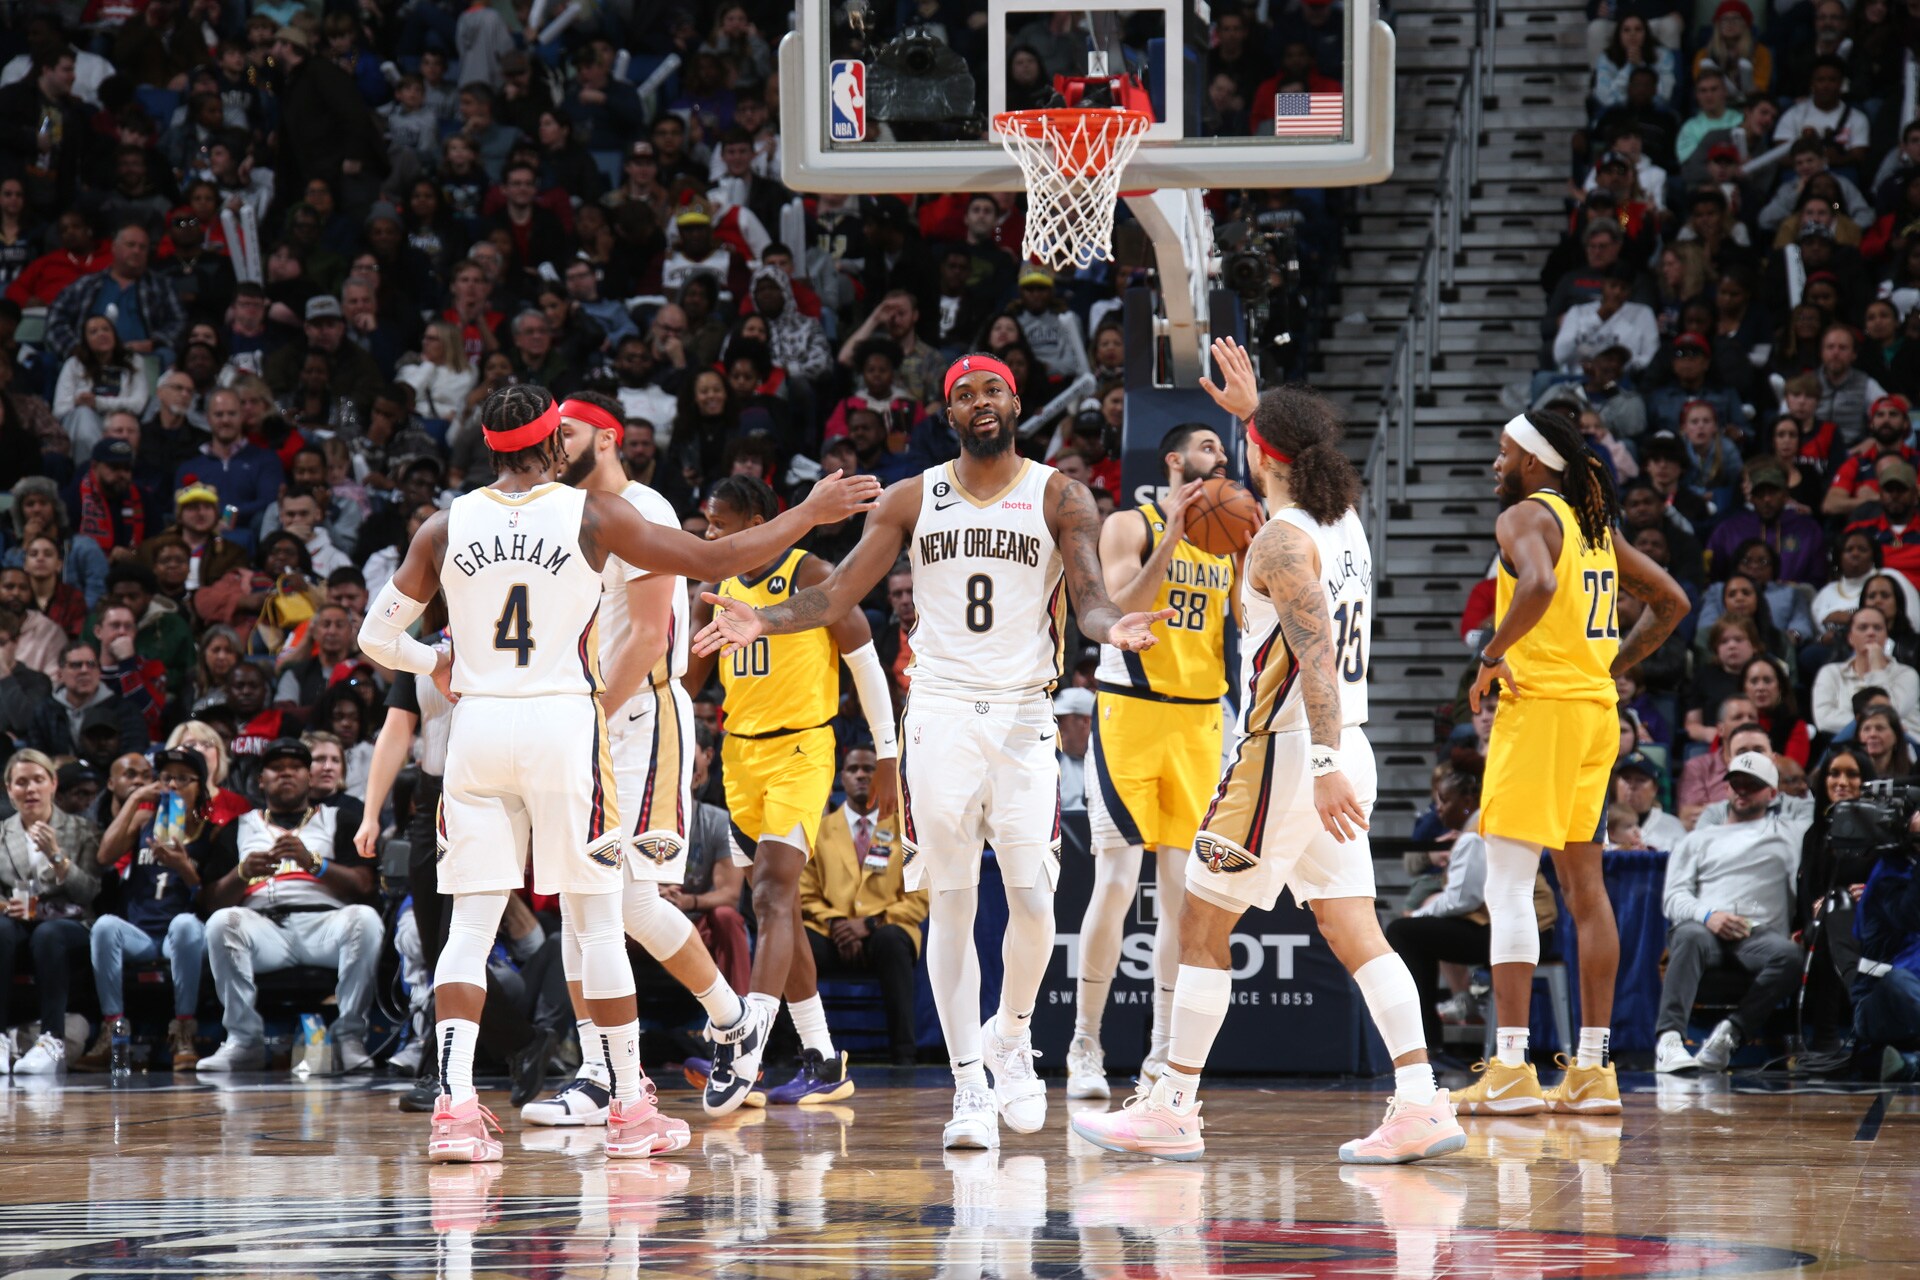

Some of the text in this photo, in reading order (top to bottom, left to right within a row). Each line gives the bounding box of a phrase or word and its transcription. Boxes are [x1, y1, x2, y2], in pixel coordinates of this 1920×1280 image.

[835, 122, 852, 136] NBA
[1001, 501, 1033, 511] ibotta
[453, 534, 571, 577] GRAHAM
[919, 528, 1041, 568] NEW ORLEANS
[1165, 560, 1229, 591] NDIANA
[966, 573, 994, 634] 8
[1583, 570, 1619, 639] 22
[493, 583, 536, 668] 4
[1333, 600, 1364, 684] 15
[155, 871, 169, 900] 1
[1054, 933, 1311, 980] TSOT
[1271, 992, 1313, 1005] 1853
[725, 1025, 746, 1042] NIKE
